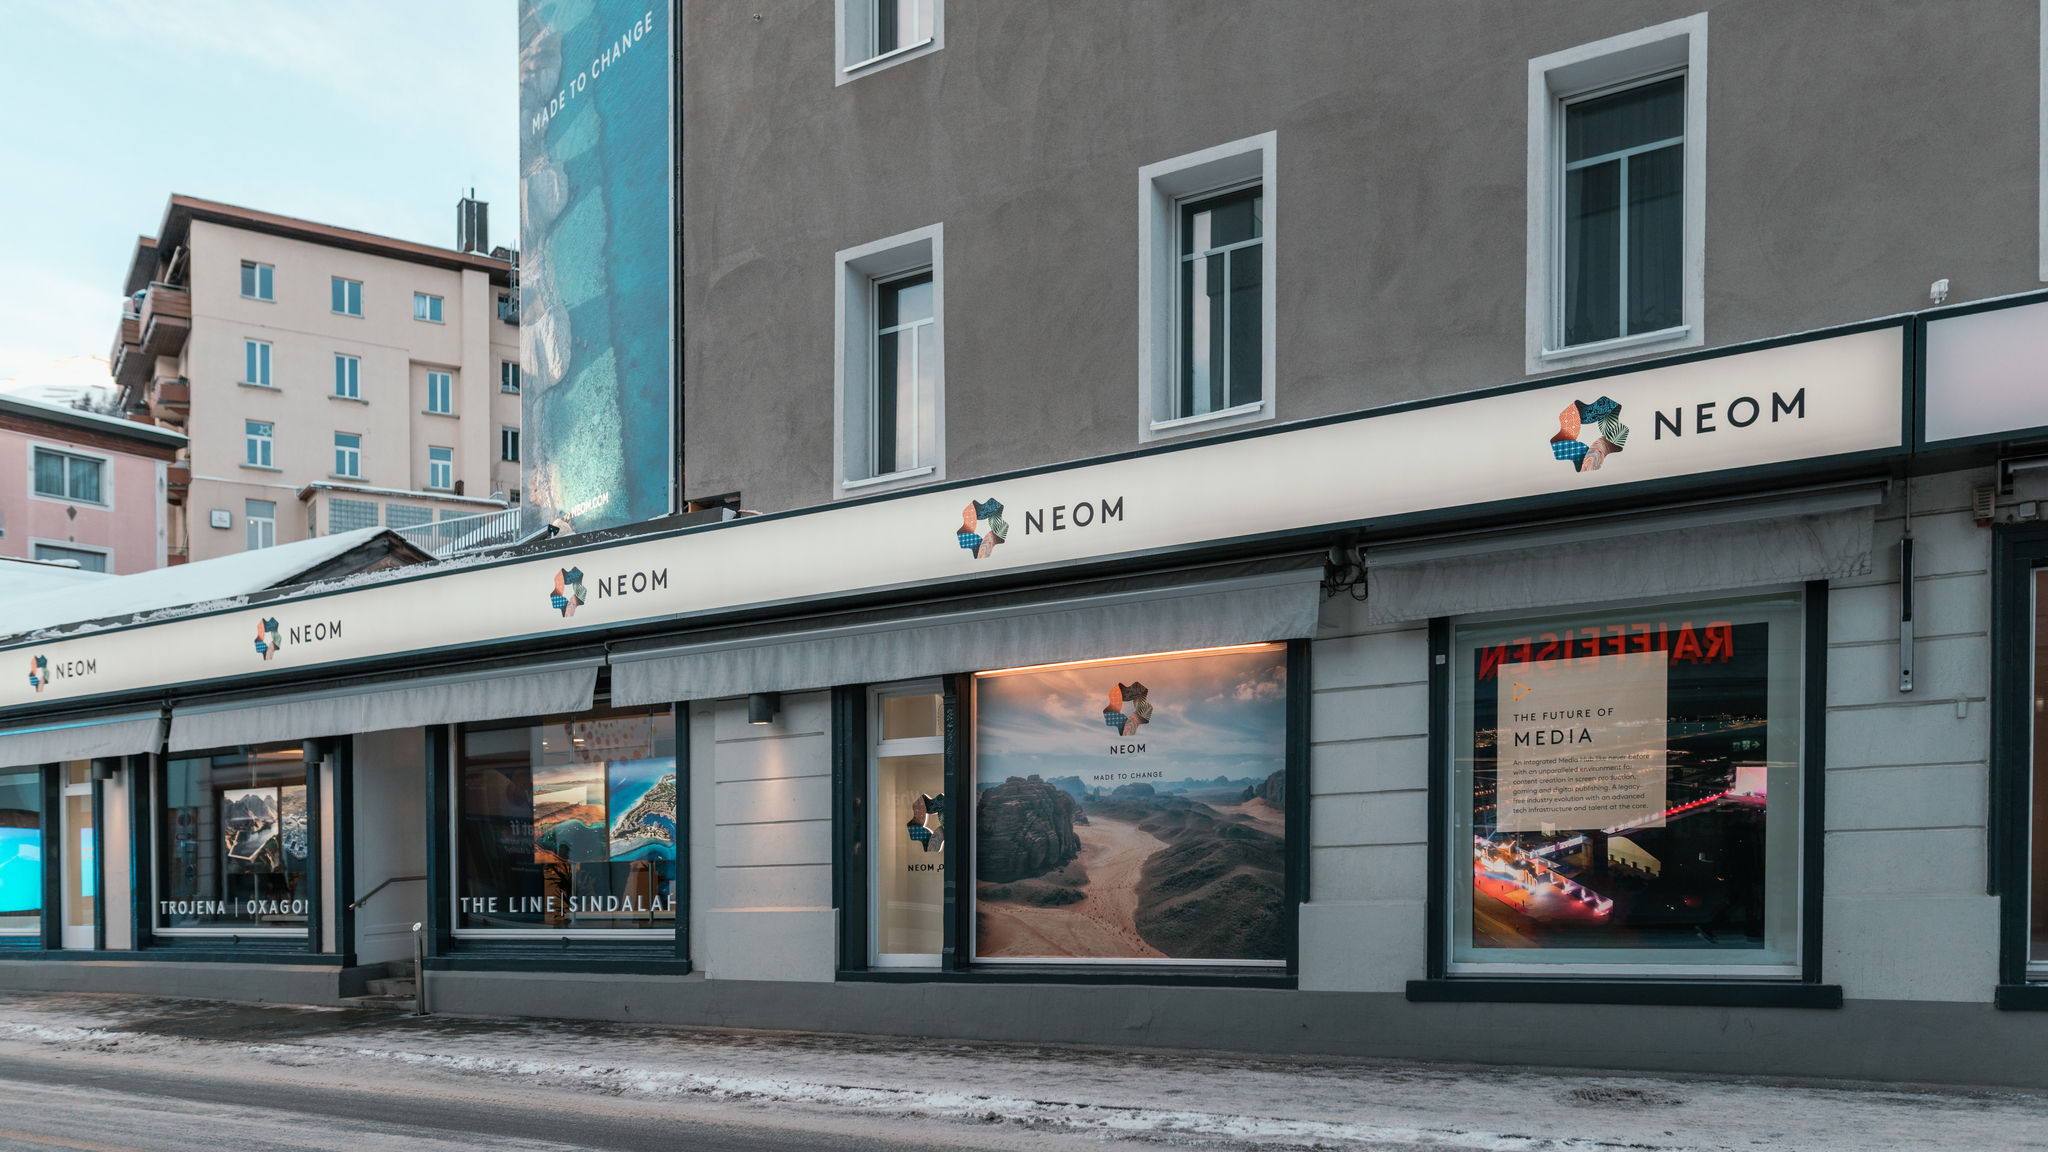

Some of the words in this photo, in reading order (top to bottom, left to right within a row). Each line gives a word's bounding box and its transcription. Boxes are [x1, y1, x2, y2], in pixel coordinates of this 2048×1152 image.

[532, 90, 565, 135] MADE
[569, 72, 586, 99] TO
[591, 10, 653, 79] CHANGE
[1655, 387, 1805, 440] NEOM
[571, 491, 609, 518] NEOM.COM
[1025, 496, 1123, 535] NEOM
[599, 567, 667, 599] NEOM
[290, 620, 342, 645] NEOM
[56, 658, 97, 679] NEOM
[1513, 713, 1536, 722] THE
[1543, 709, 1591, 720] FUTURE
[1597, 708, 1613, 716] OF
[1514, 728, 1592, 747] MEDIA
[1110, 744, 1146, 755] NEOM
[1130, 771, 1163, 779] CHANGE
[907, 864, 934, 872] NEOM
[160, 900, 226, 915] TROJENA
[460, 896, 498, 913] THE
[509, 896, 556, 913] LINE
